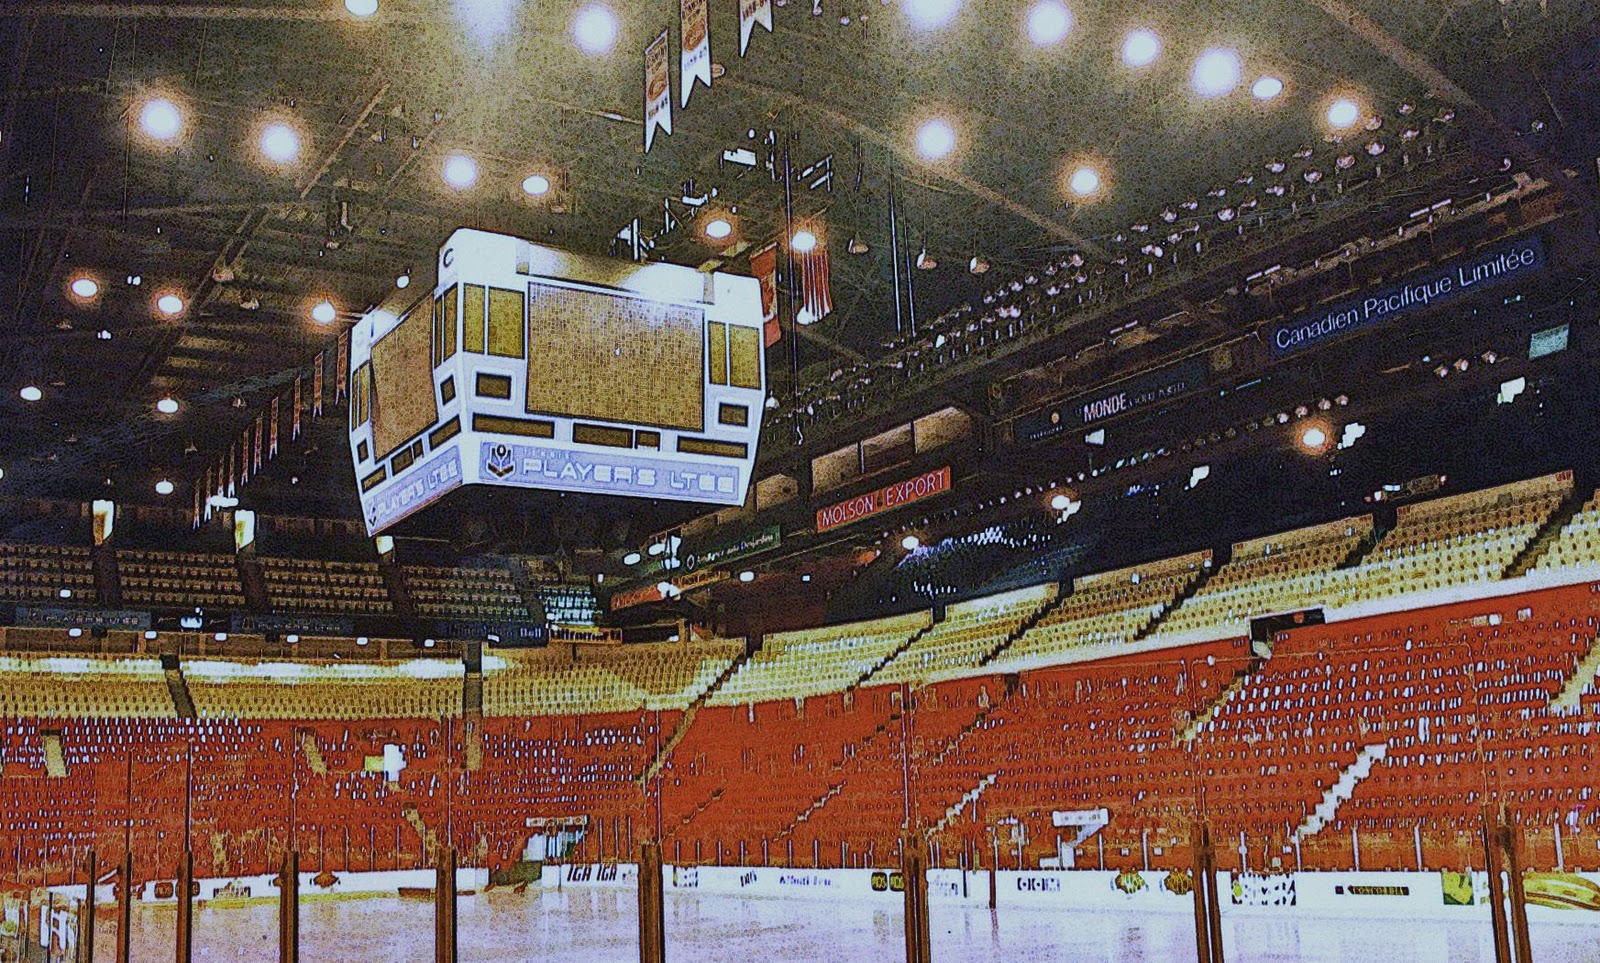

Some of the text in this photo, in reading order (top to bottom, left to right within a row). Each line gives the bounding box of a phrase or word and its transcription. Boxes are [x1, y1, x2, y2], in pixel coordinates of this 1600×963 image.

[1275, 248, 1535, 349] Canadien Pacifique Limitée
[1083, 392, 1127, 423] MONDE
[822, 471, 945, 526] MOLSON EXPORT
